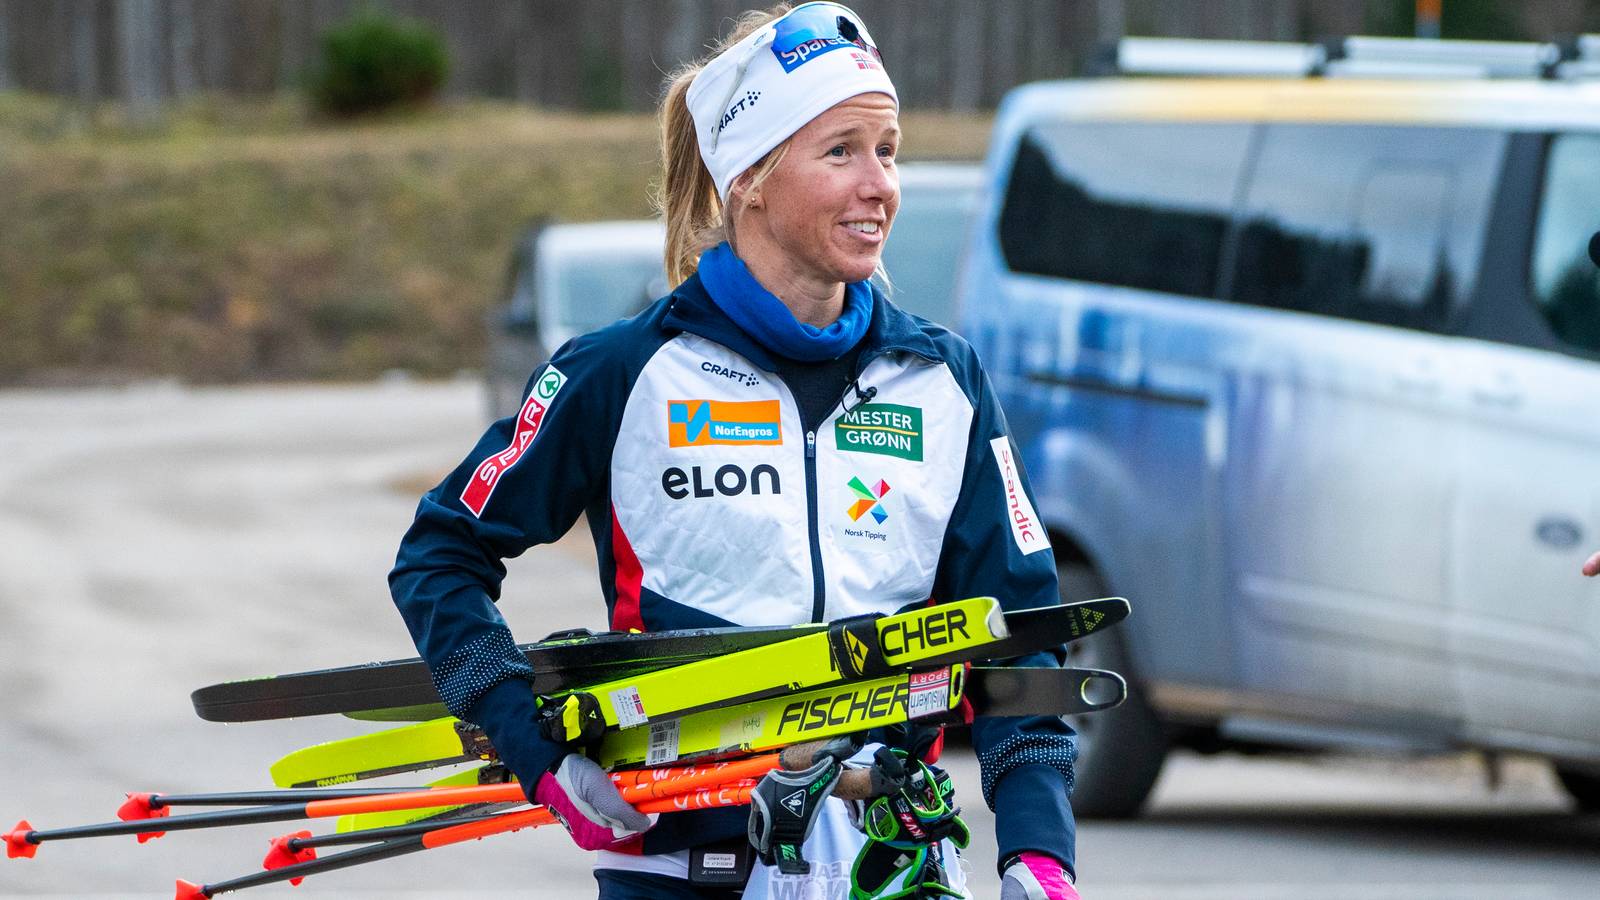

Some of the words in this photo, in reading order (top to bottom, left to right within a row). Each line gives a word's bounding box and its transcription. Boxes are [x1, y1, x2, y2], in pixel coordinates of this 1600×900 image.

[701, 361, 748, 384] CRAFT
[843, 410, 912, 430] MESTER
[715, 425, 773, 438] NorEngros
[846, 431, 911, 451] GRØNN
[480, 402, 542, 486] SPAR
[844, 528, 864, 538] Norsk
[864, 530, 887, 541] Tipping
[912, 671, 949, 683] SPORT
[777, 682, 908, 736] FISCHER
